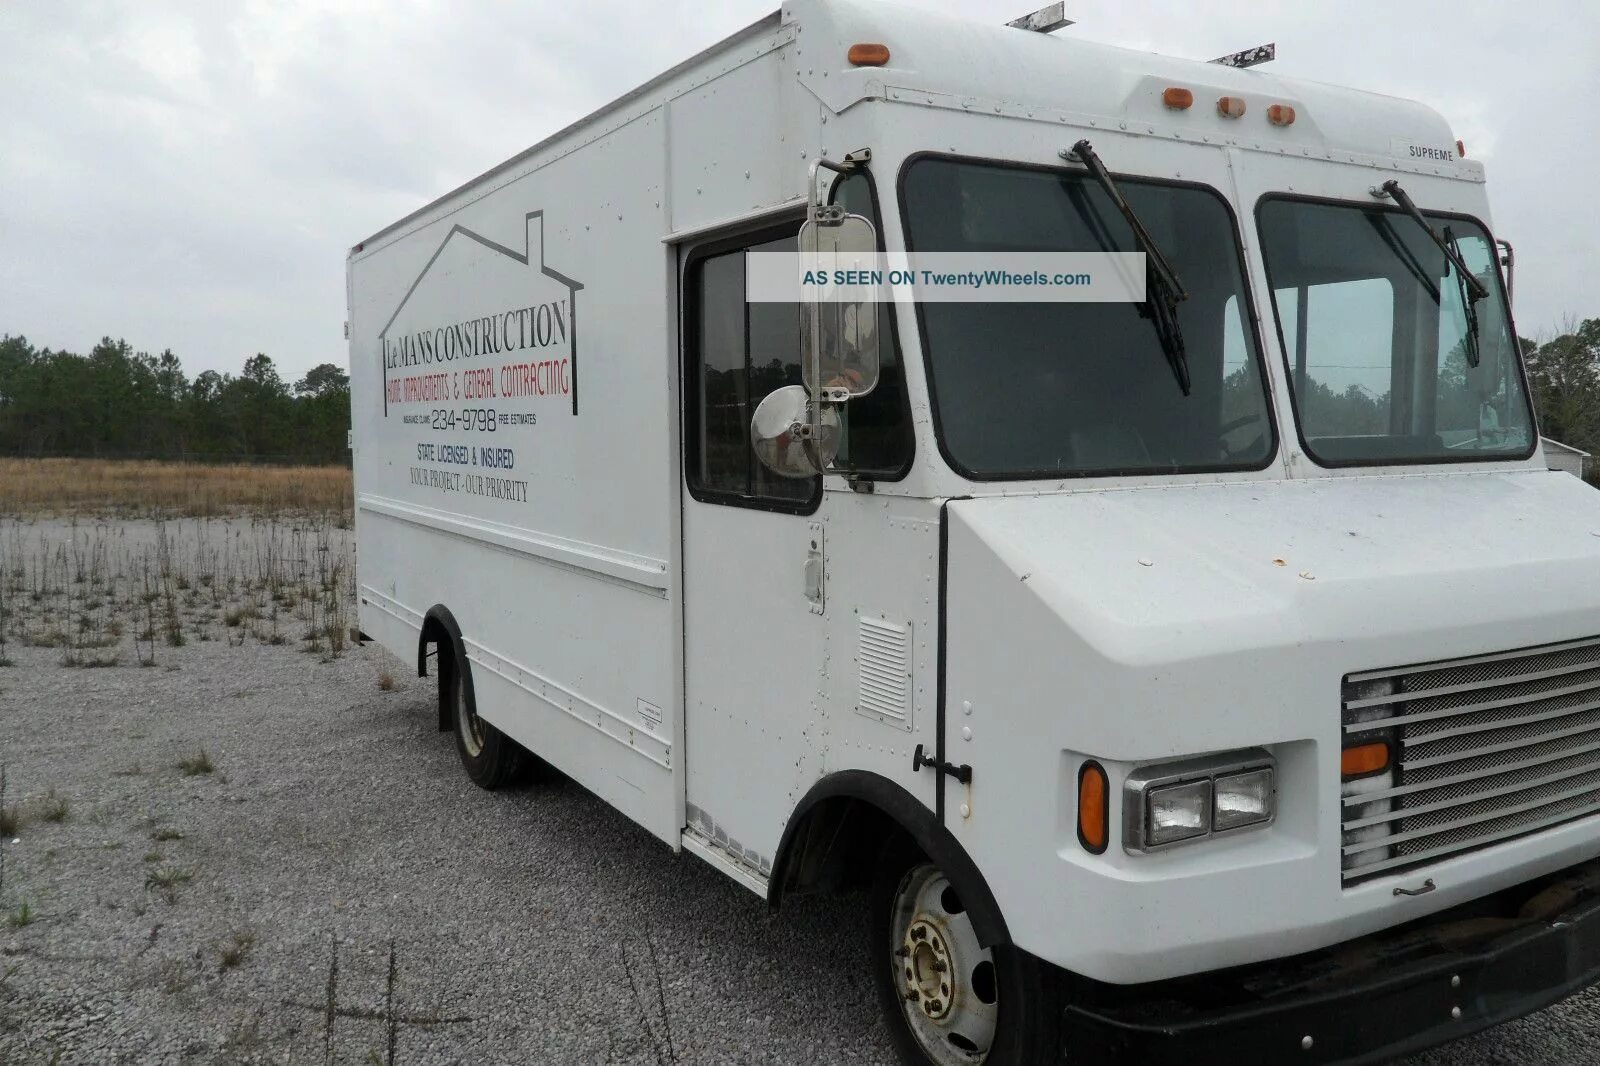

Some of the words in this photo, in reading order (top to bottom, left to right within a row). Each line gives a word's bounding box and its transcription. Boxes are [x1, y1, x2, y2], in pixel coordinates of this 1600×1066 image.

[1410, 146, 1453, 161] SUPREME
[435, 300, 566, 363] CONSTRUCTION
[388, 378, 401, 403] HOME
[404, 373, 449, 402] IMPROVEMENTS
[454, 372, 459, 400] &
[464, 367, 496, 400] GENERAL
[501, 358, 569, 396] CONTRACTING
[432, 409, 496, 432] 234-9798
[498, 414, 509, 424] FREE
[511, 414, 536, 425] ESTIMATES
[417, 443, 434, 461] STATE
[438, 445, 468, 465] LICENSED
[472, 447, 477, 465] &
[481, 448, 514, 469] INSURED
[410, 467, 429, 484] YOUR
[430, 471, 460, 493] PROJECT
[466, 475, 484, 496] OUR
[486, 479, 528, 503] PRIORITY
